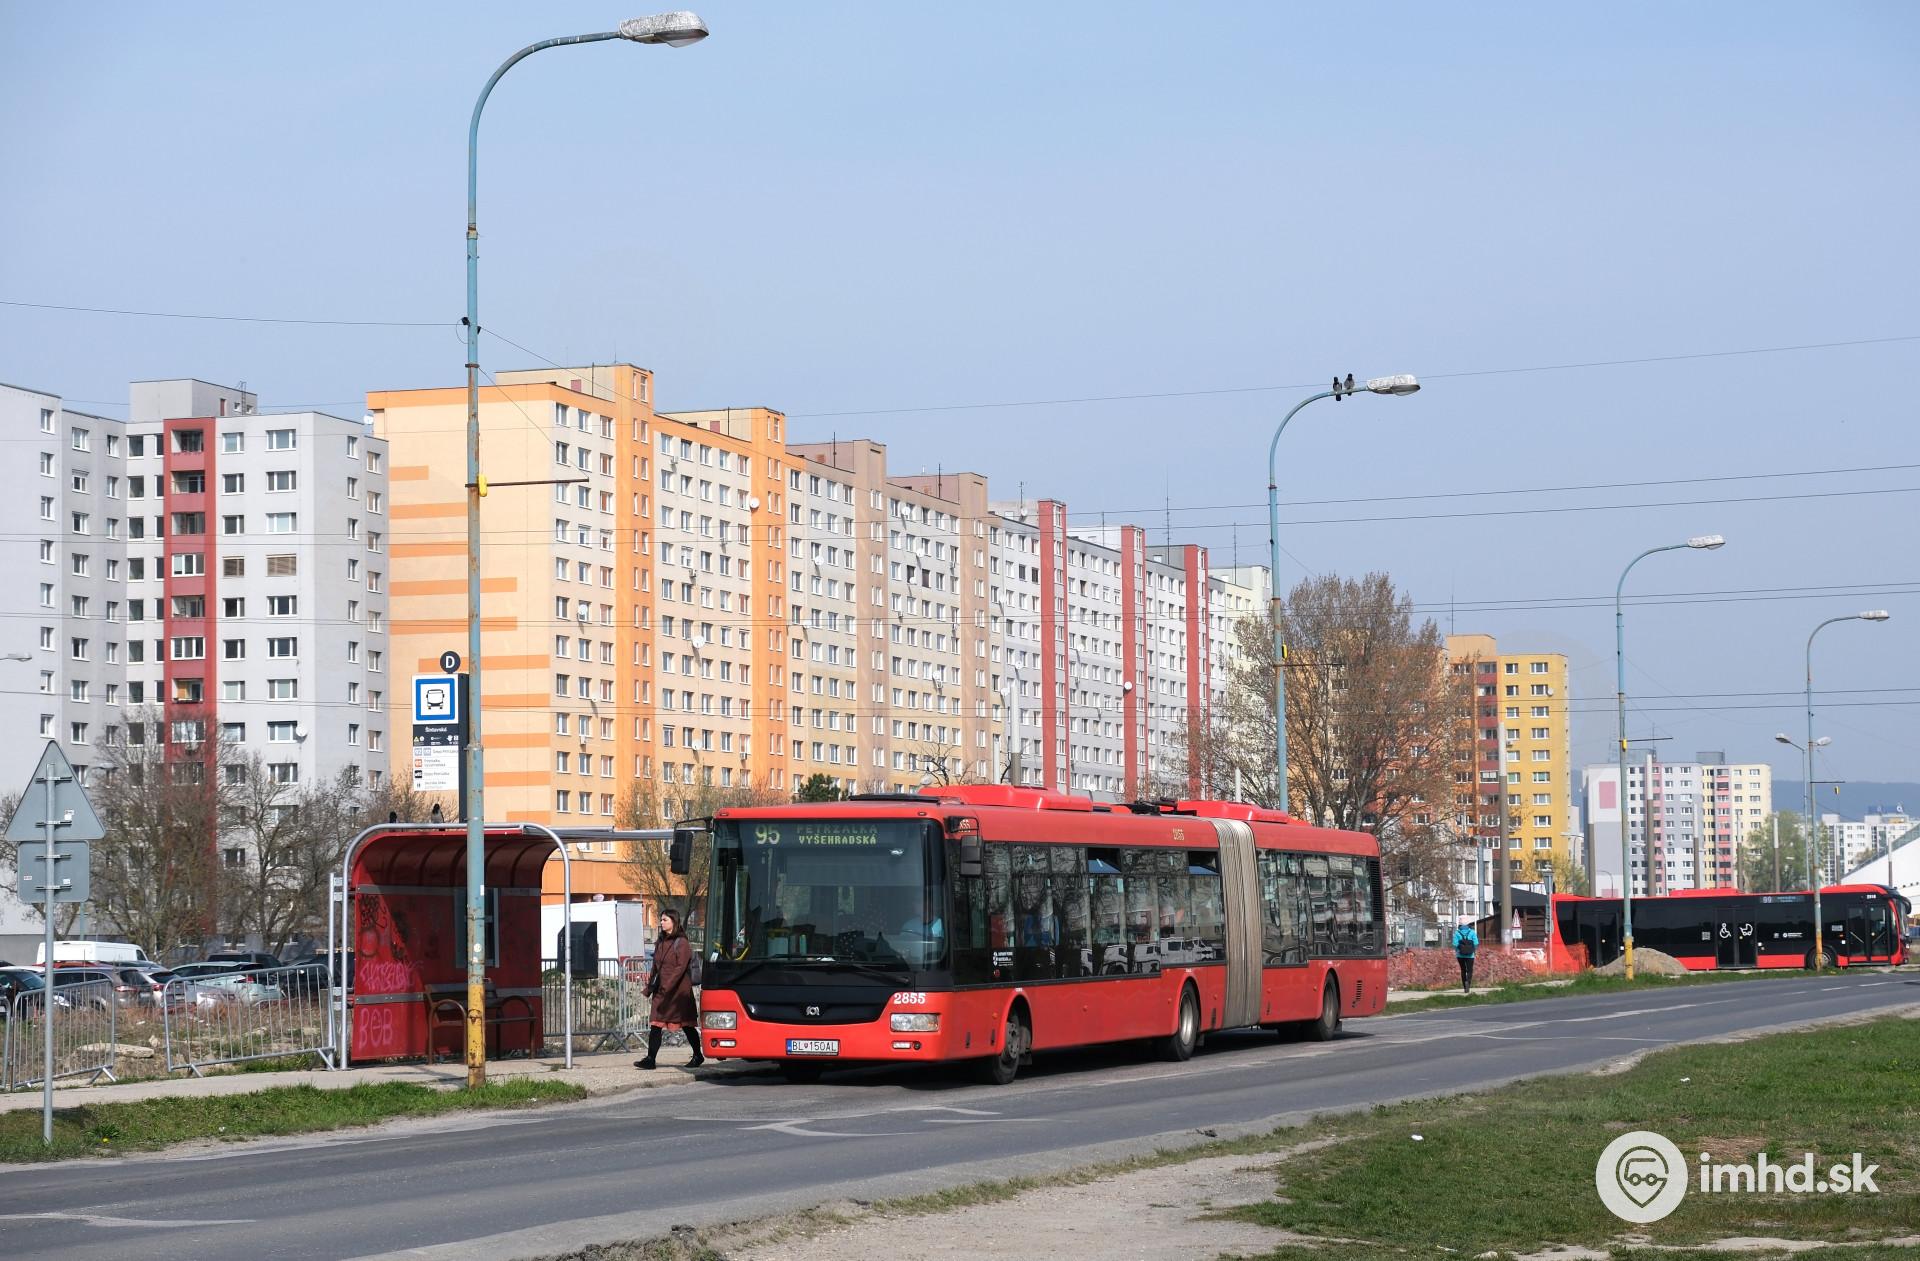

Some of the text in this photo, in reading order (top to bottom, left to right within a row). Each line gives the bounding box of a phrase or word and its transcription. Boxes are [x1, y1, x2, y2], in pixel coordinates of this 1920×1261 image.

[445, 656, 455, 669] D
[755, 825, 780, 845] 95
[799, 834, 877, 845] VYŠEHRADSKÁ
[894, 992, 925, 1004] 2855
